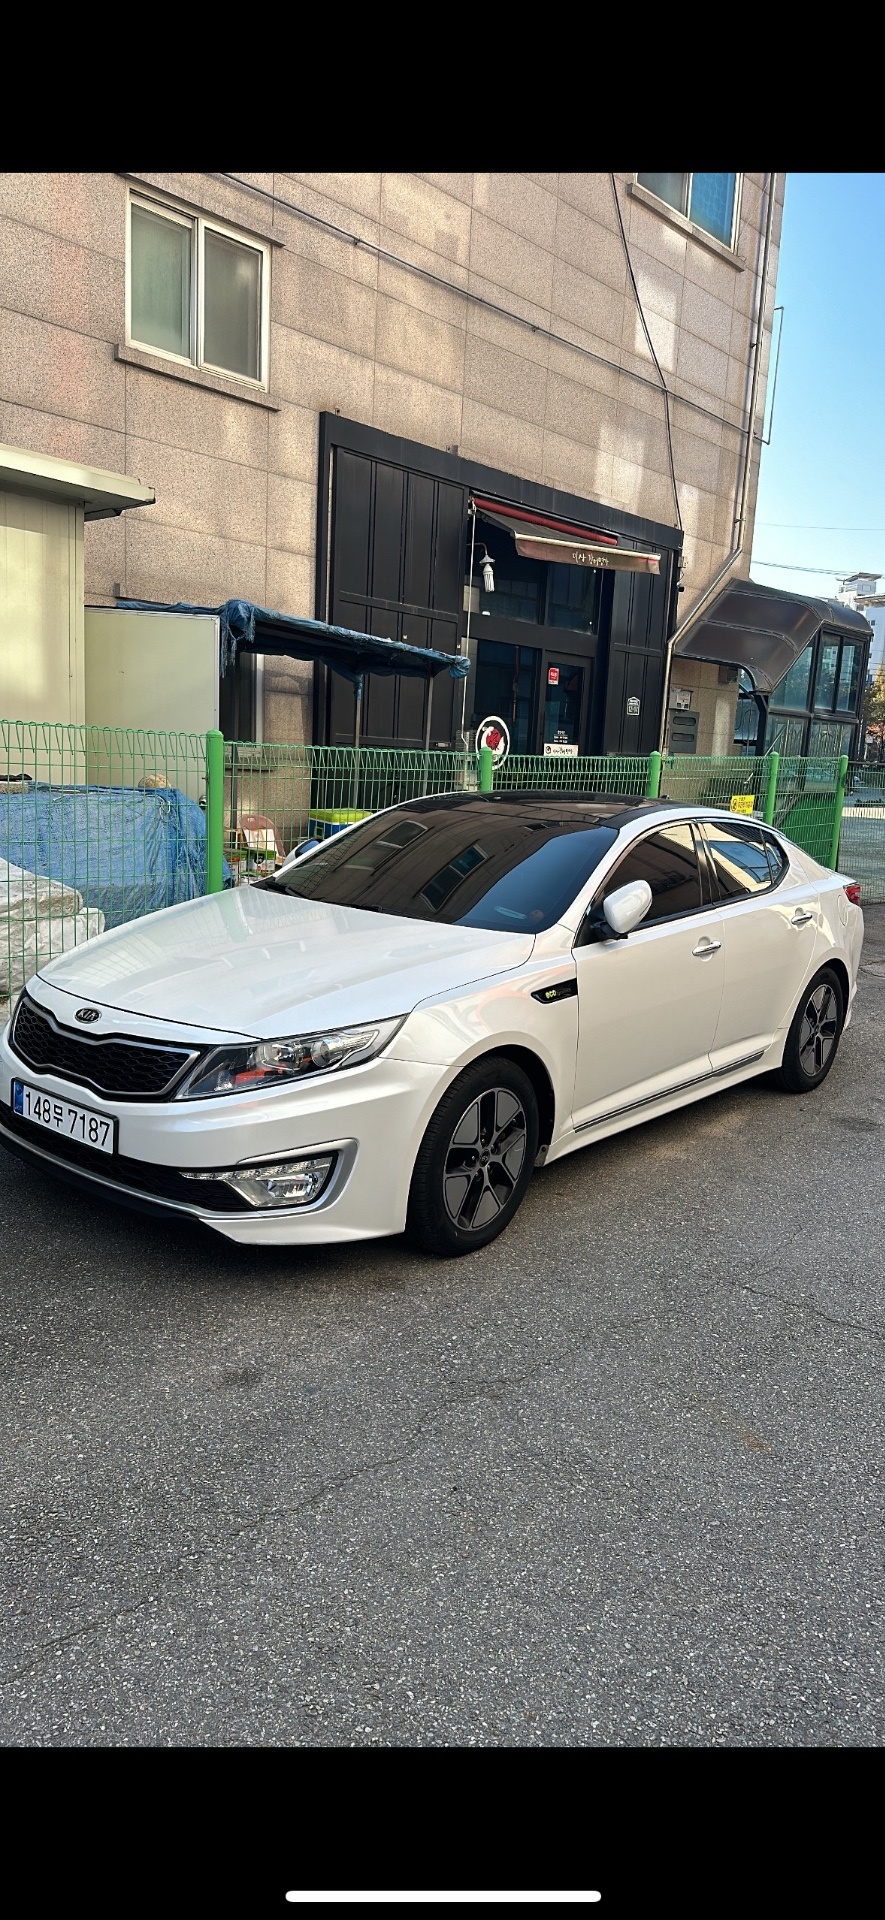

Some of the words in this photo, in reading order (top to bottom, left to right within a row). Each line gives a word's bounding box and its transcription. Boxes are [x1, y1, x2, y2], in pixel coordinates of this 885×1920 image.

[77, 1009, 97, 1021] KIA
[25, 1091, 64, 1128] 148무
[68, 1108, 111, 1147] 7187
